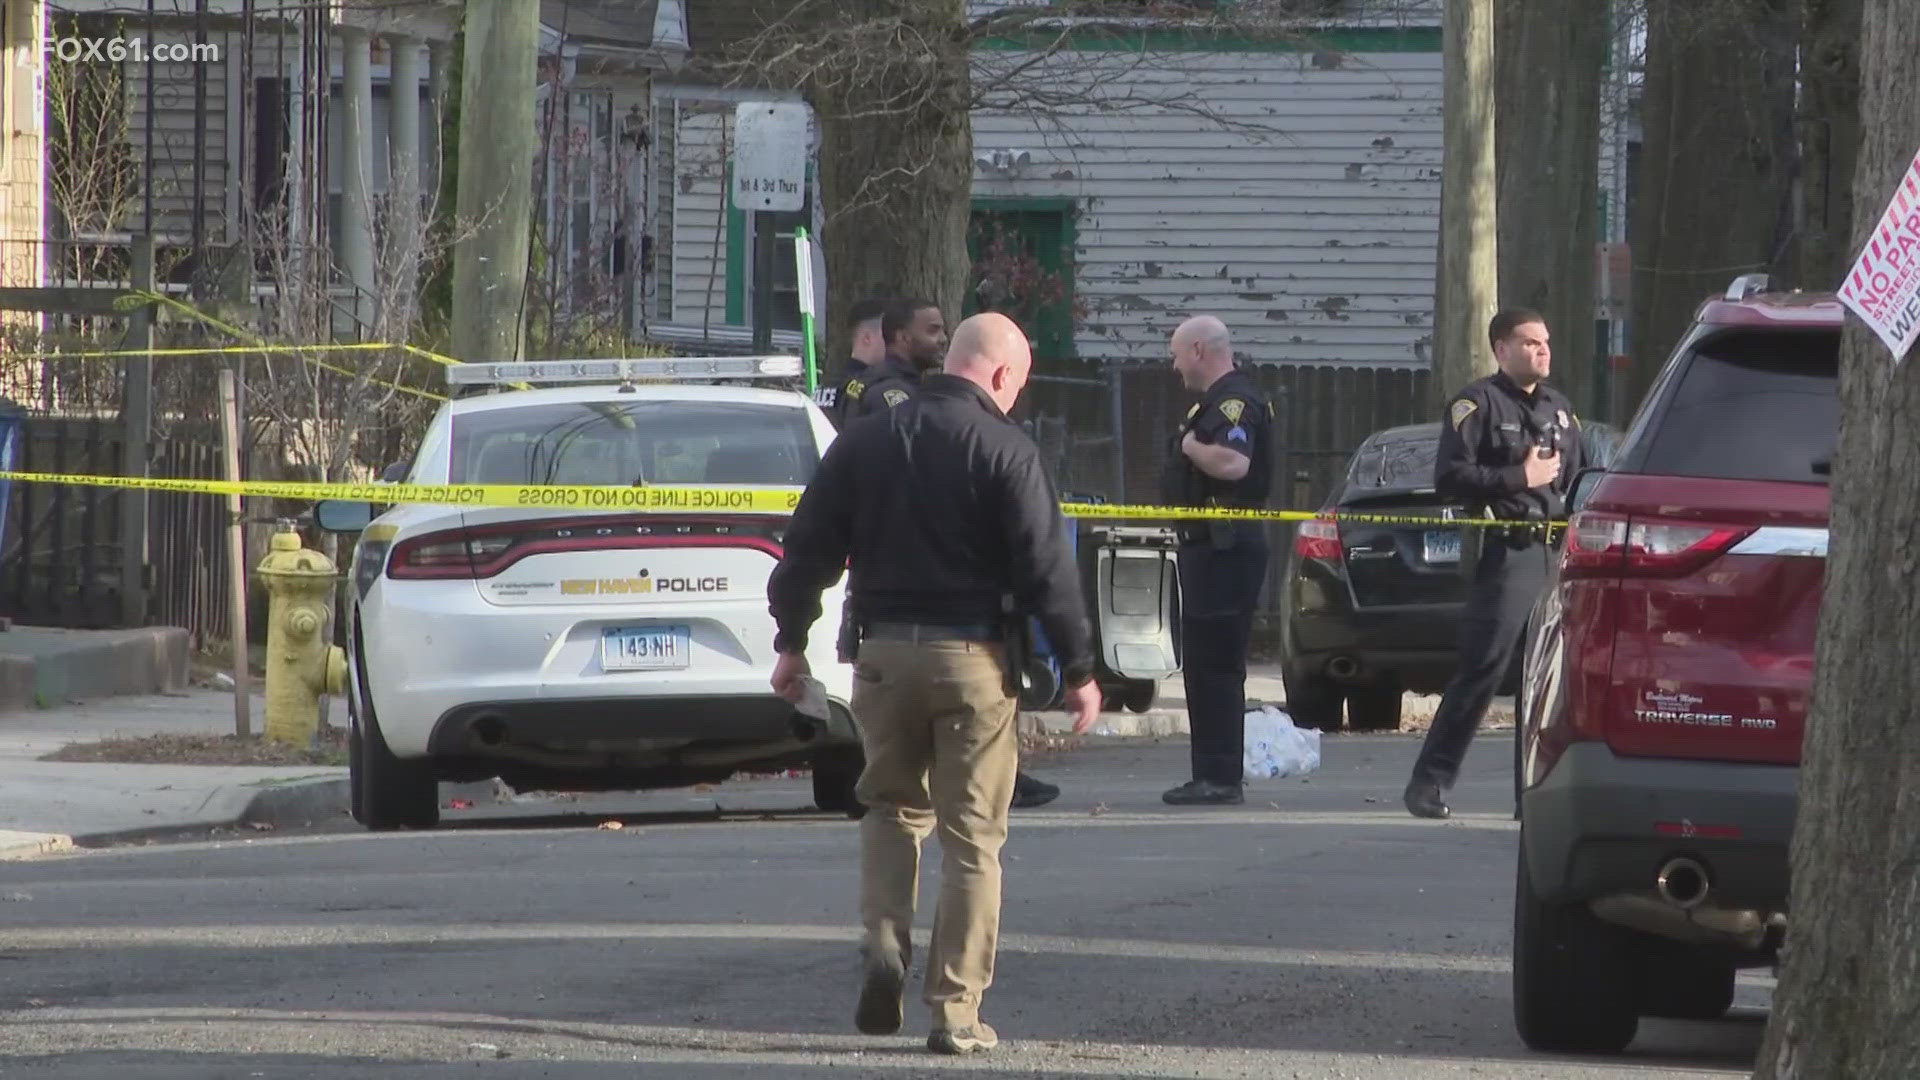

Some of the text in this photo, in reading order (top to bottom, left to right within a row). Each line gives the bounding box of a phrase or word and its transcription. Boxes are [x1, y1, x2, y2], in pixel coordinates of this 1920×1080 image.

[762, 179, 775, 193] 3rd
[779, 179, 798, 194] Thurs
[1858, 270, 1890, 314] NO
[1873, 253, 1916, 321] STREET
[561, 579, 597, 595] NEW
[598, 577, 652, 594] HAVEN
[657, 577, 729, 592] POLICE
[1635, 710, 1776, 729] TRAVERSE AWD
